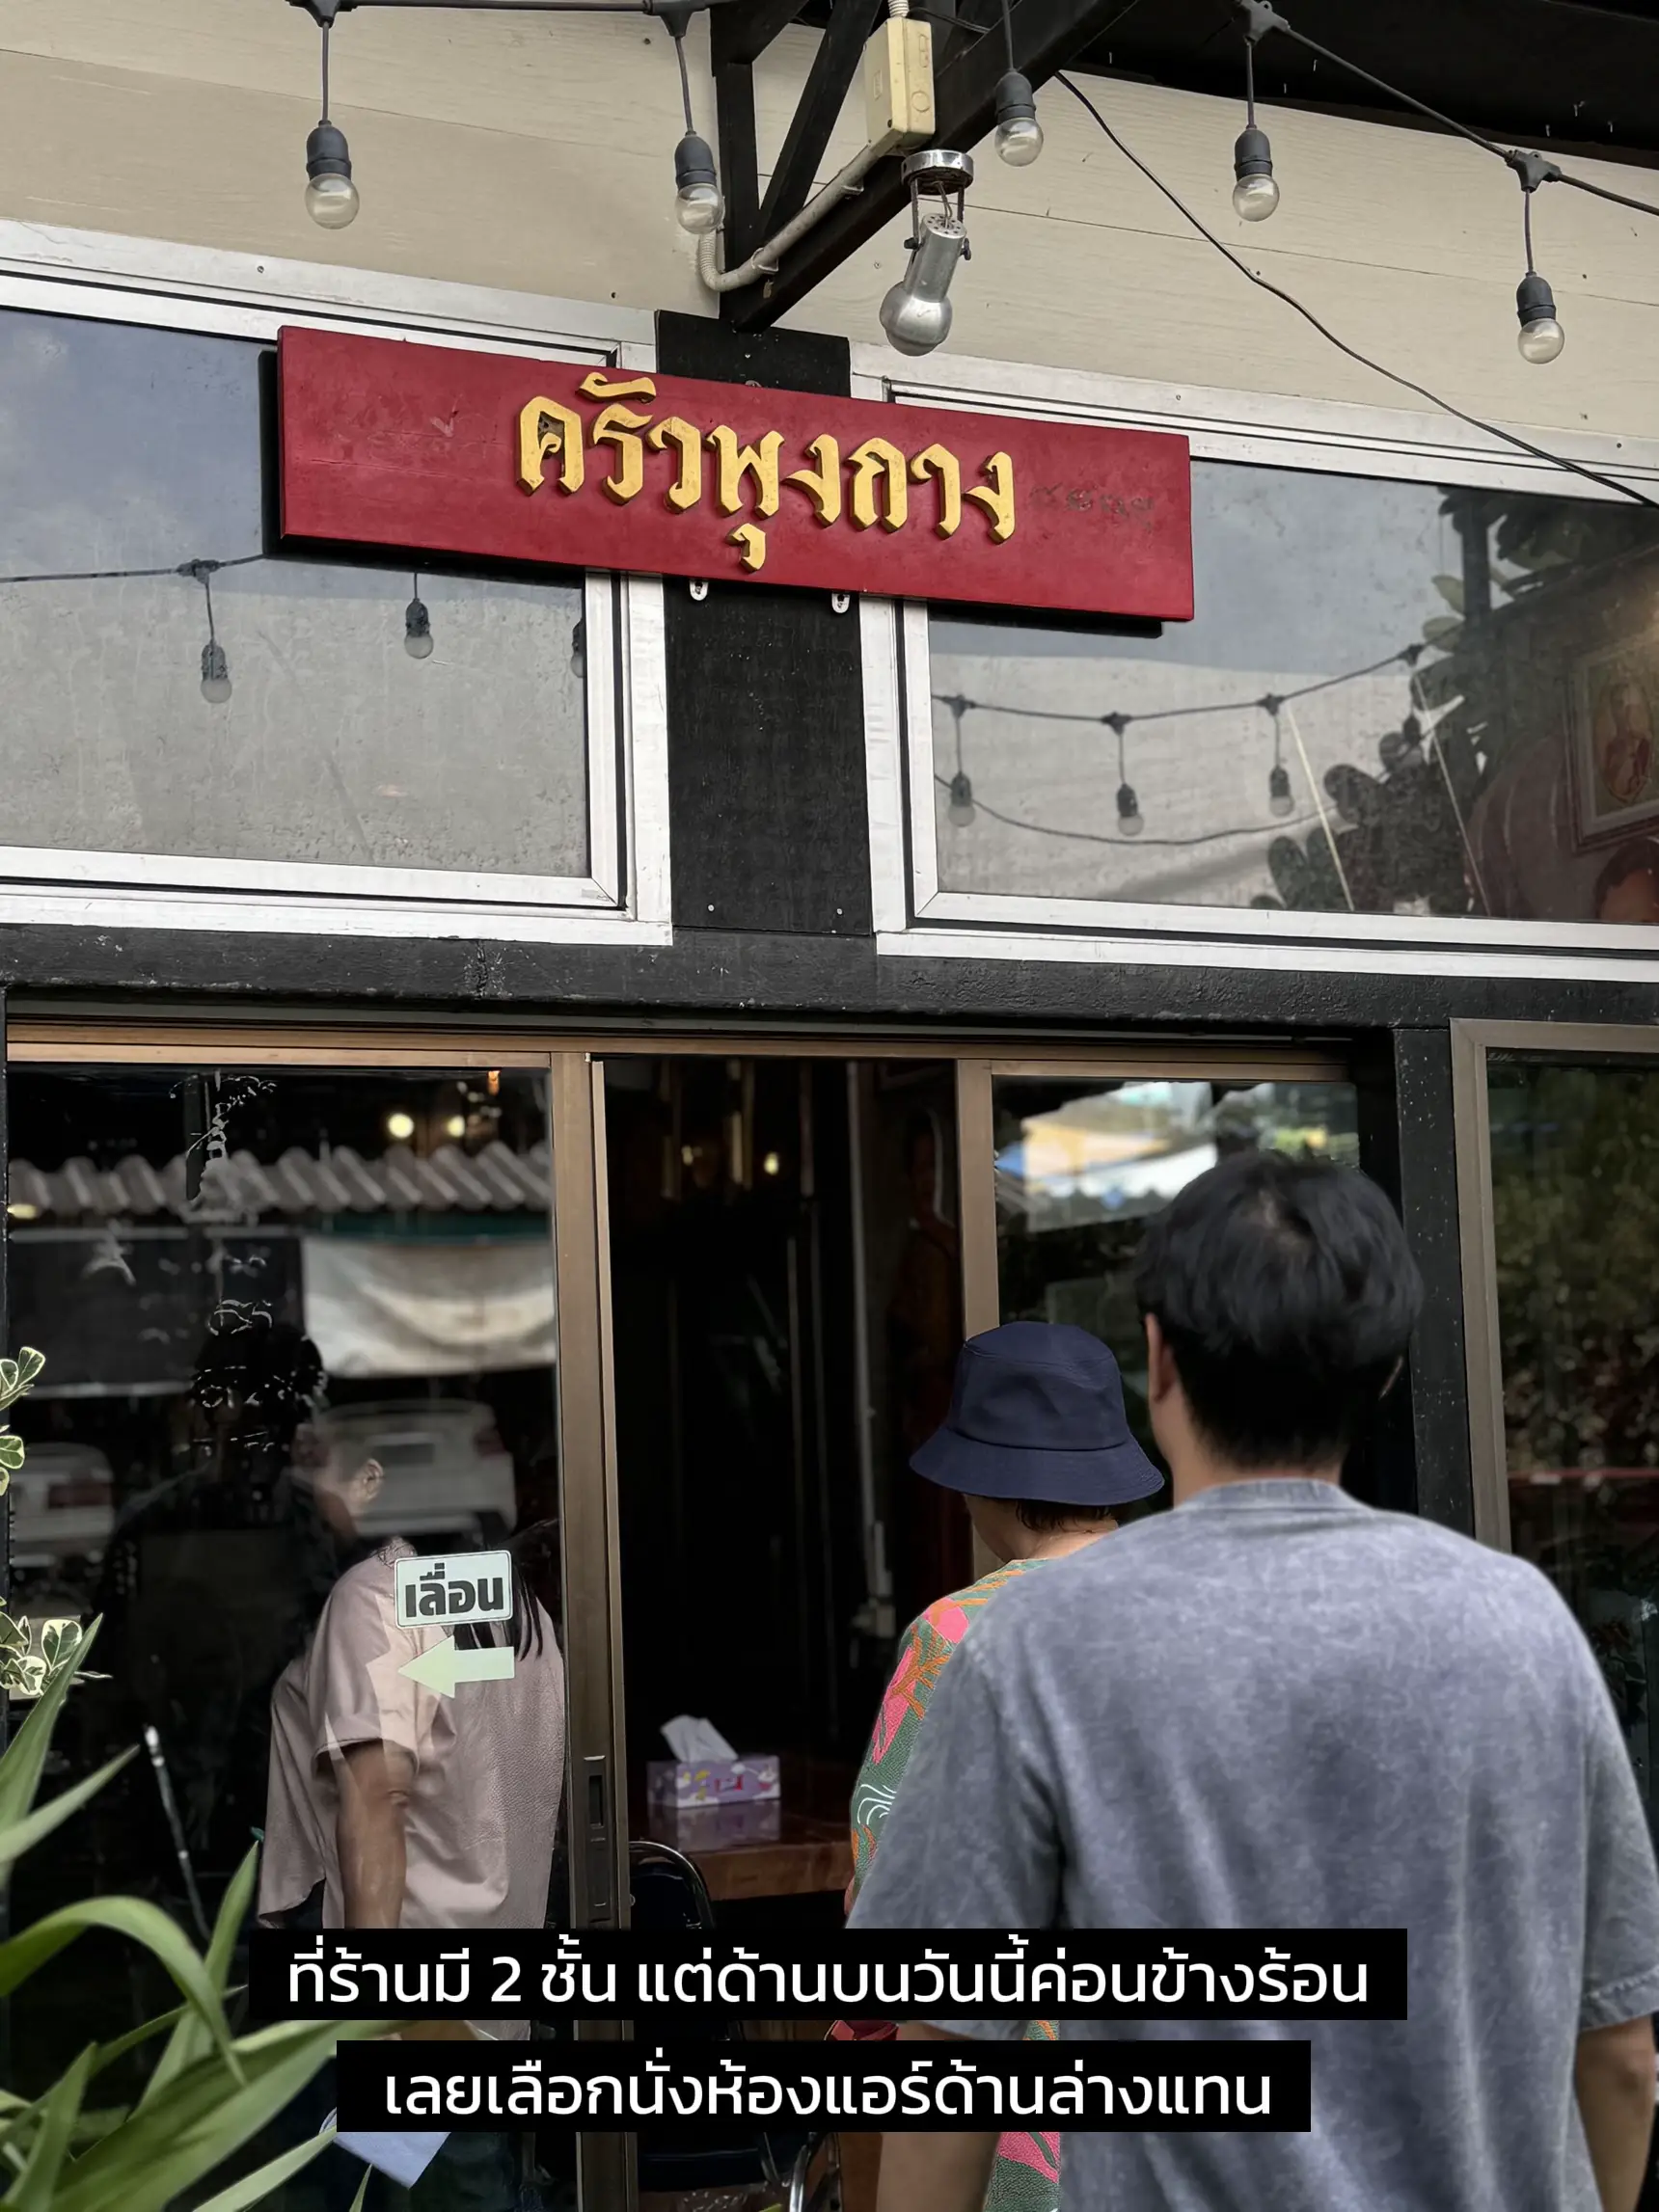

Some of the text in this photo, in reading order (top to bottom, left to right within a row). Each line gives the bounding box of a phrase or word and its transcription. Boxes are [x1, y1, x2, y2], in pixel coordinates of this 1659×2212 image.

[517, 371, 1017, 572] ครัวพุงกาง
[404, 1562, 504, 1618] เลื่อน
